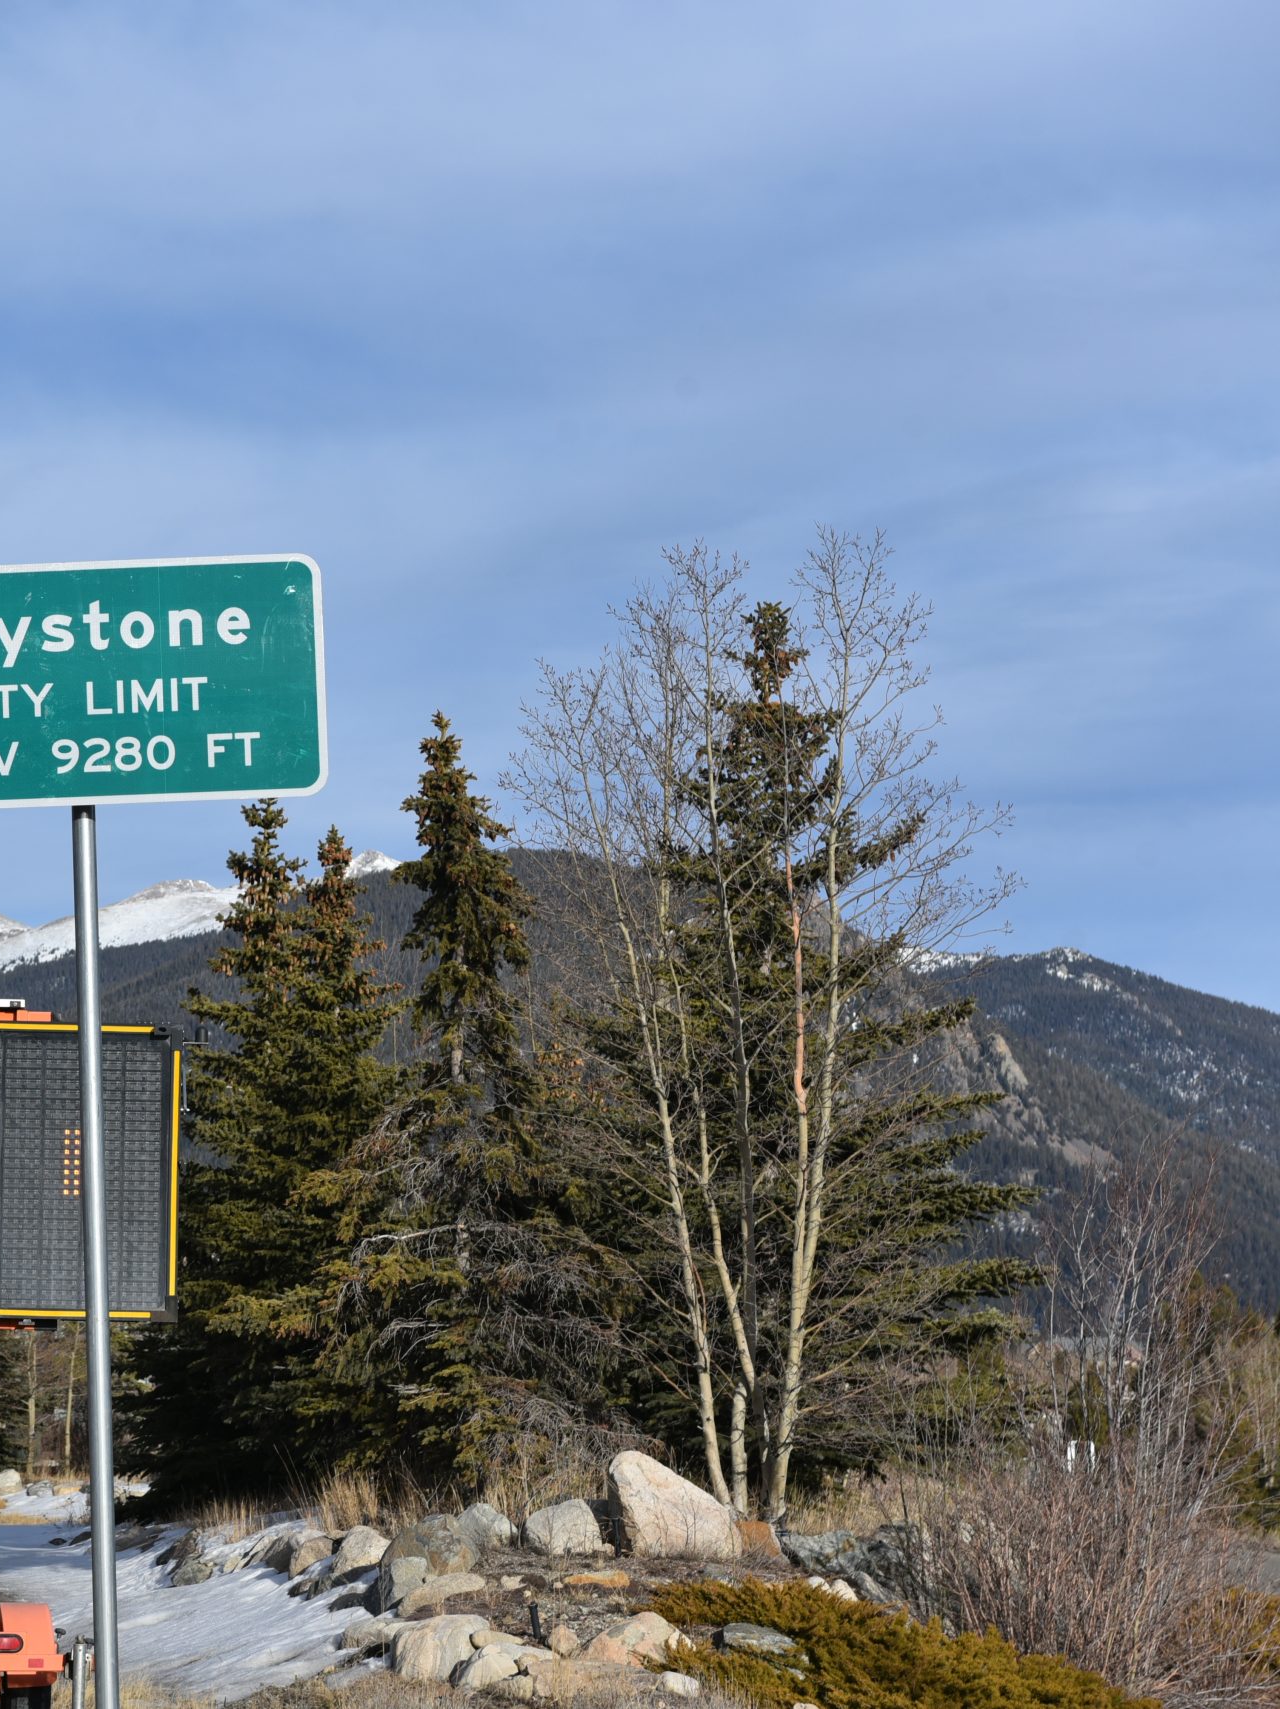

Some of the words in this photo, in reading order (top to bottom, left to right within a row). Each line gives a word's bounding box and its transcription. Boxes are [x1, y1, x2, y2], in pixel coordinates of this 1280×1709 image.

[85, 676, 208, 715] LIMIT
[52, 734, 176, 774] 9280
[206, 731, 261, 768] FT
